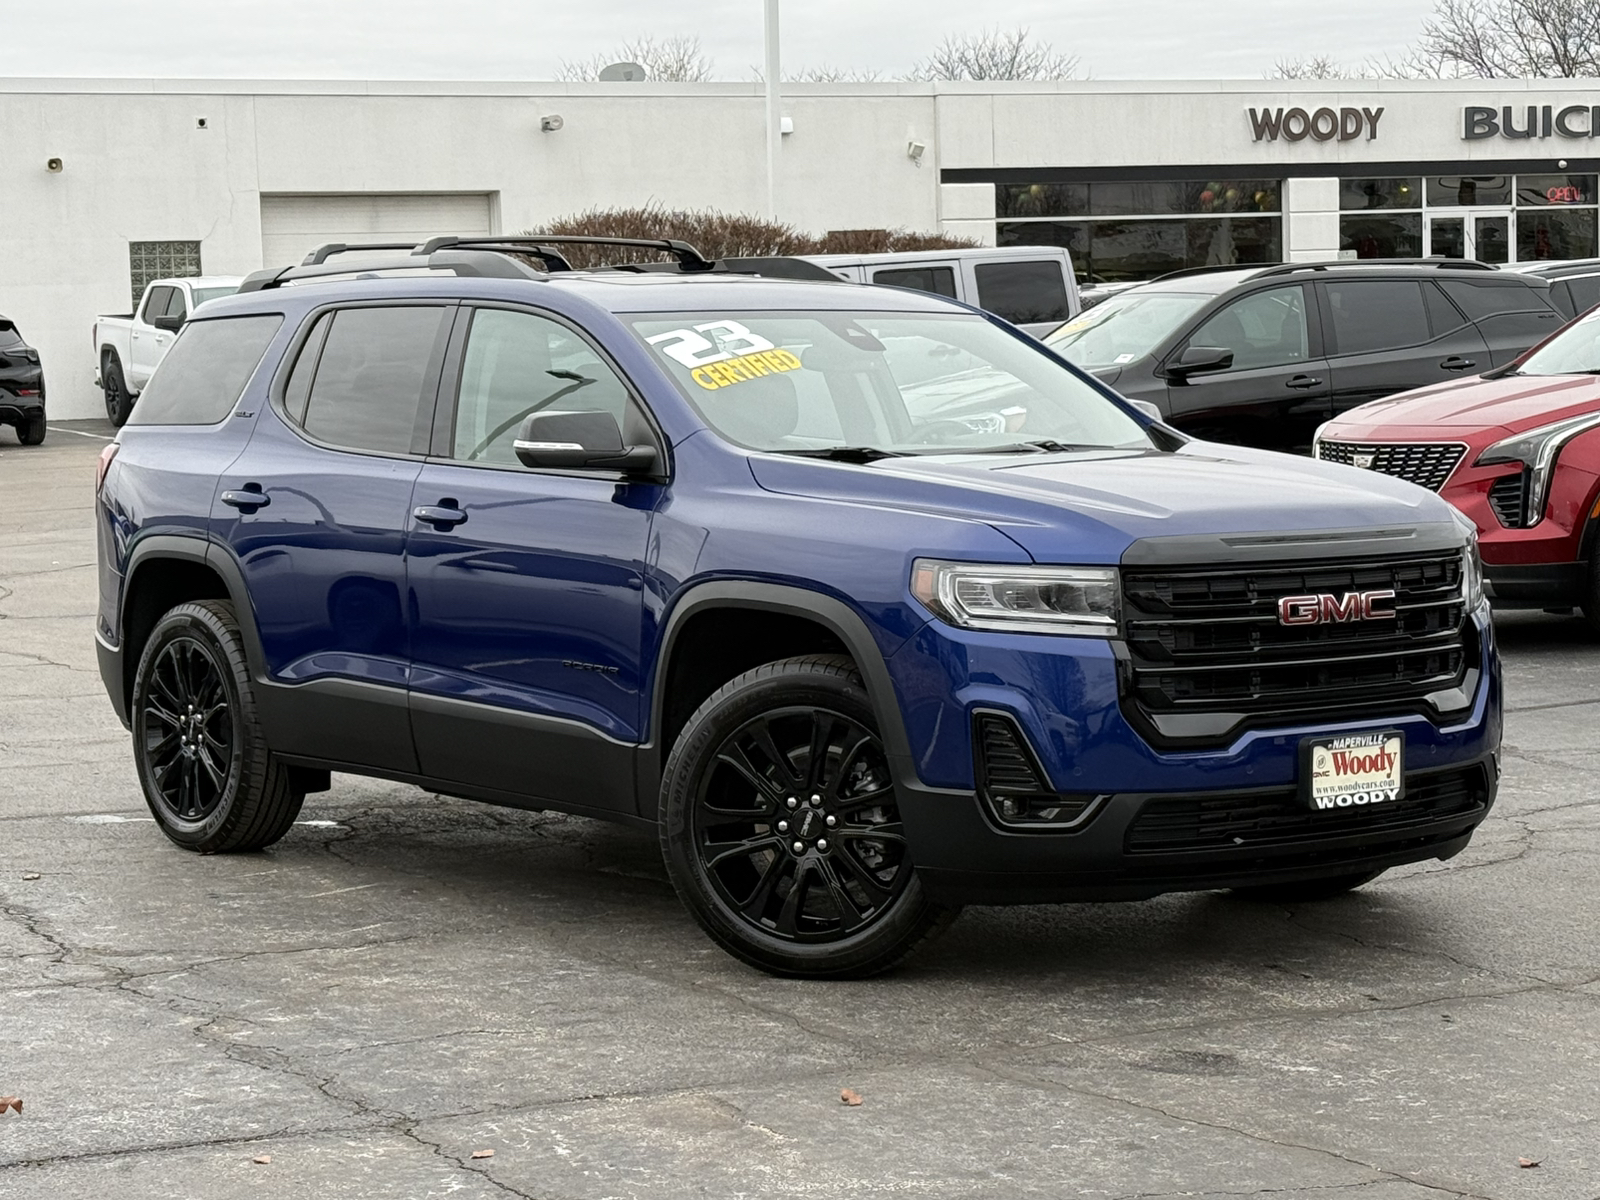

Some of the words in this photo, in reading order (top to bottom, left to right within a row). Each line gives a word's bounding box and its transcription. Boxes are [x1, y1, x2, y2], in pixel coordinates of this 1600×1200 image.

[1247, 107, 1385, 141] WOODY
[1547, 186, 1581, 202] OPEN
[644, 319, 775, 370] 23
[690, 347, 802, 391] CERTIFIED
[1278, 589, 1396, 626] GMC
[1332, 734, 1384, 749] NAPERVILLE
[674, 725, 712, 805] MICHELIN
[1331, 745, 1397, 779] Woody
[1315, 789, 1400, 809] WOODY
[1316, 779, 1395, 794] www.woodycars.com
